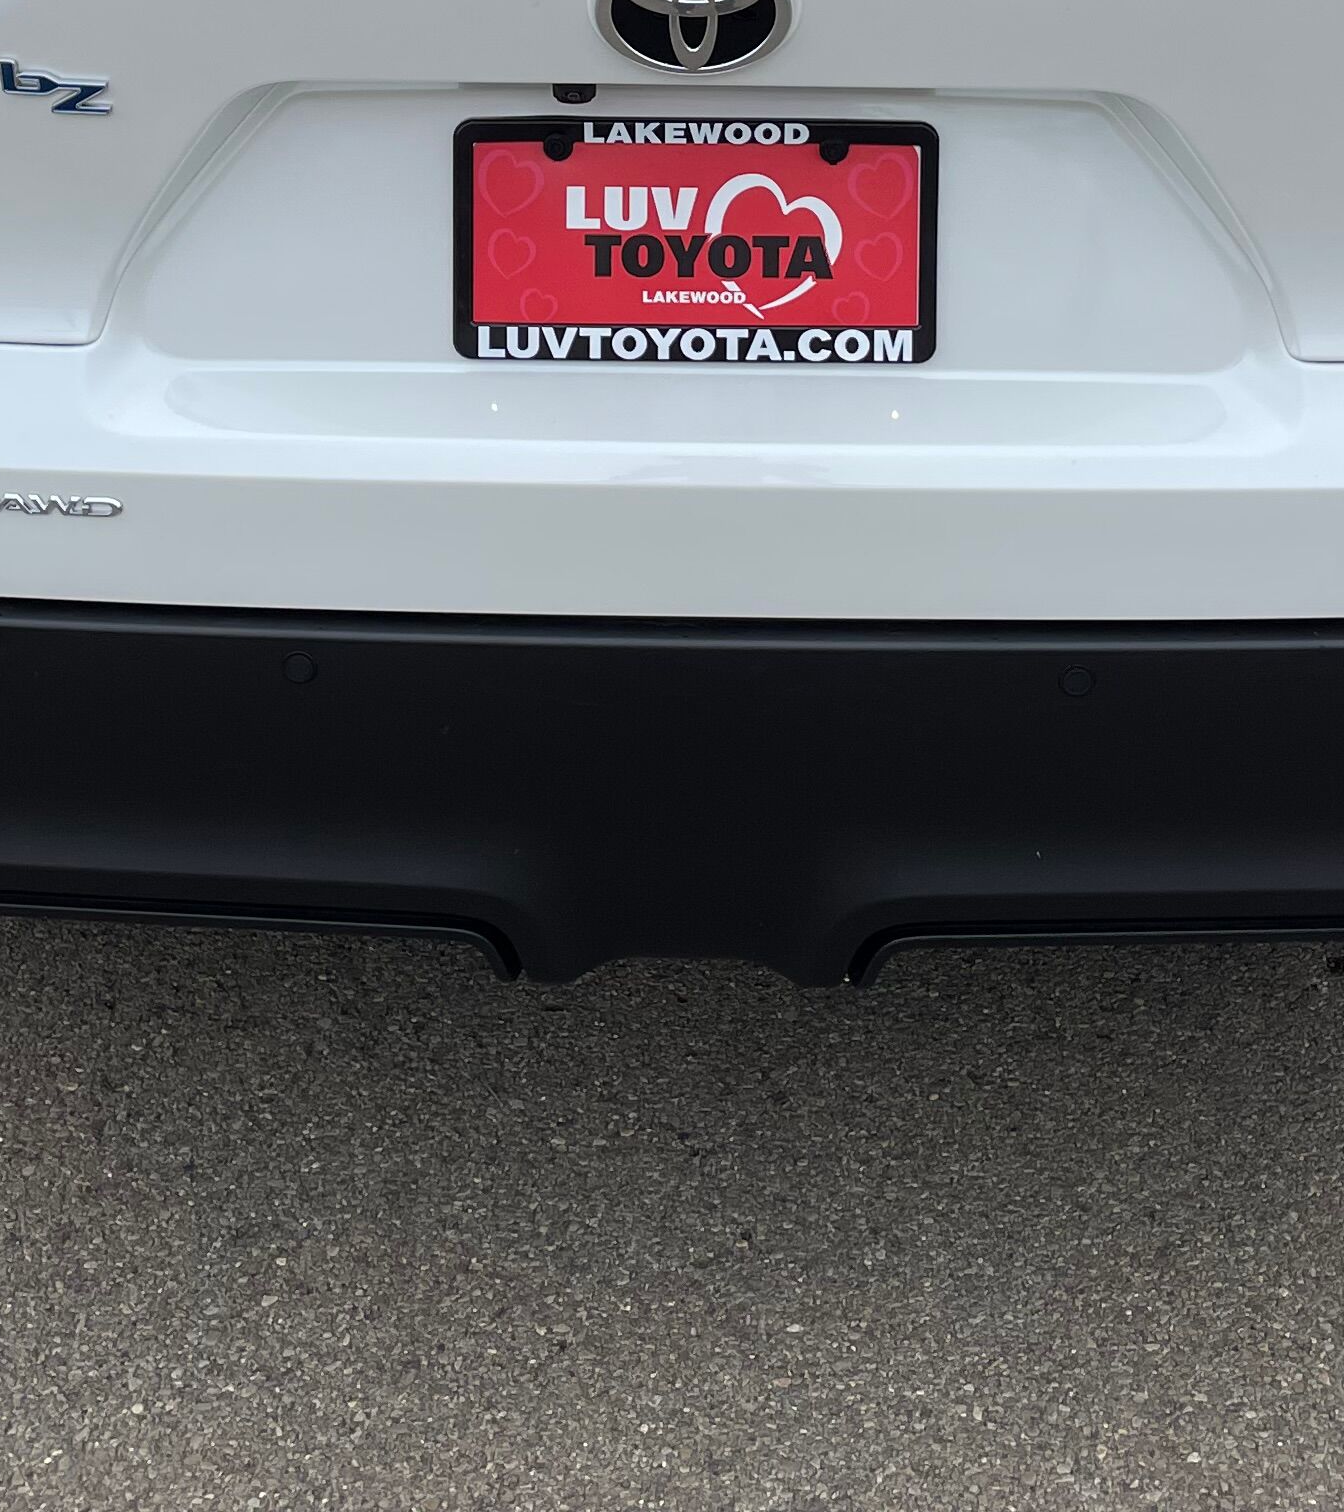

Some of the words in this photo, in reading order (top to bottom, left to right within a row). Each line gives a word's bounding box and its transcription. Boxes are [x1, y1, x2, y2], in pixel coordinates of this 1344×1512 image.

[584, 122, 810, 145] LAKEWOOD
[566, 186, 699, 230] LUV
[584, 234, 833, 280] TOYOTA
[642, 291, 747, 305] LAKEWOOD
[477, 326, 913, 362] LUVTOYOTA.COM
